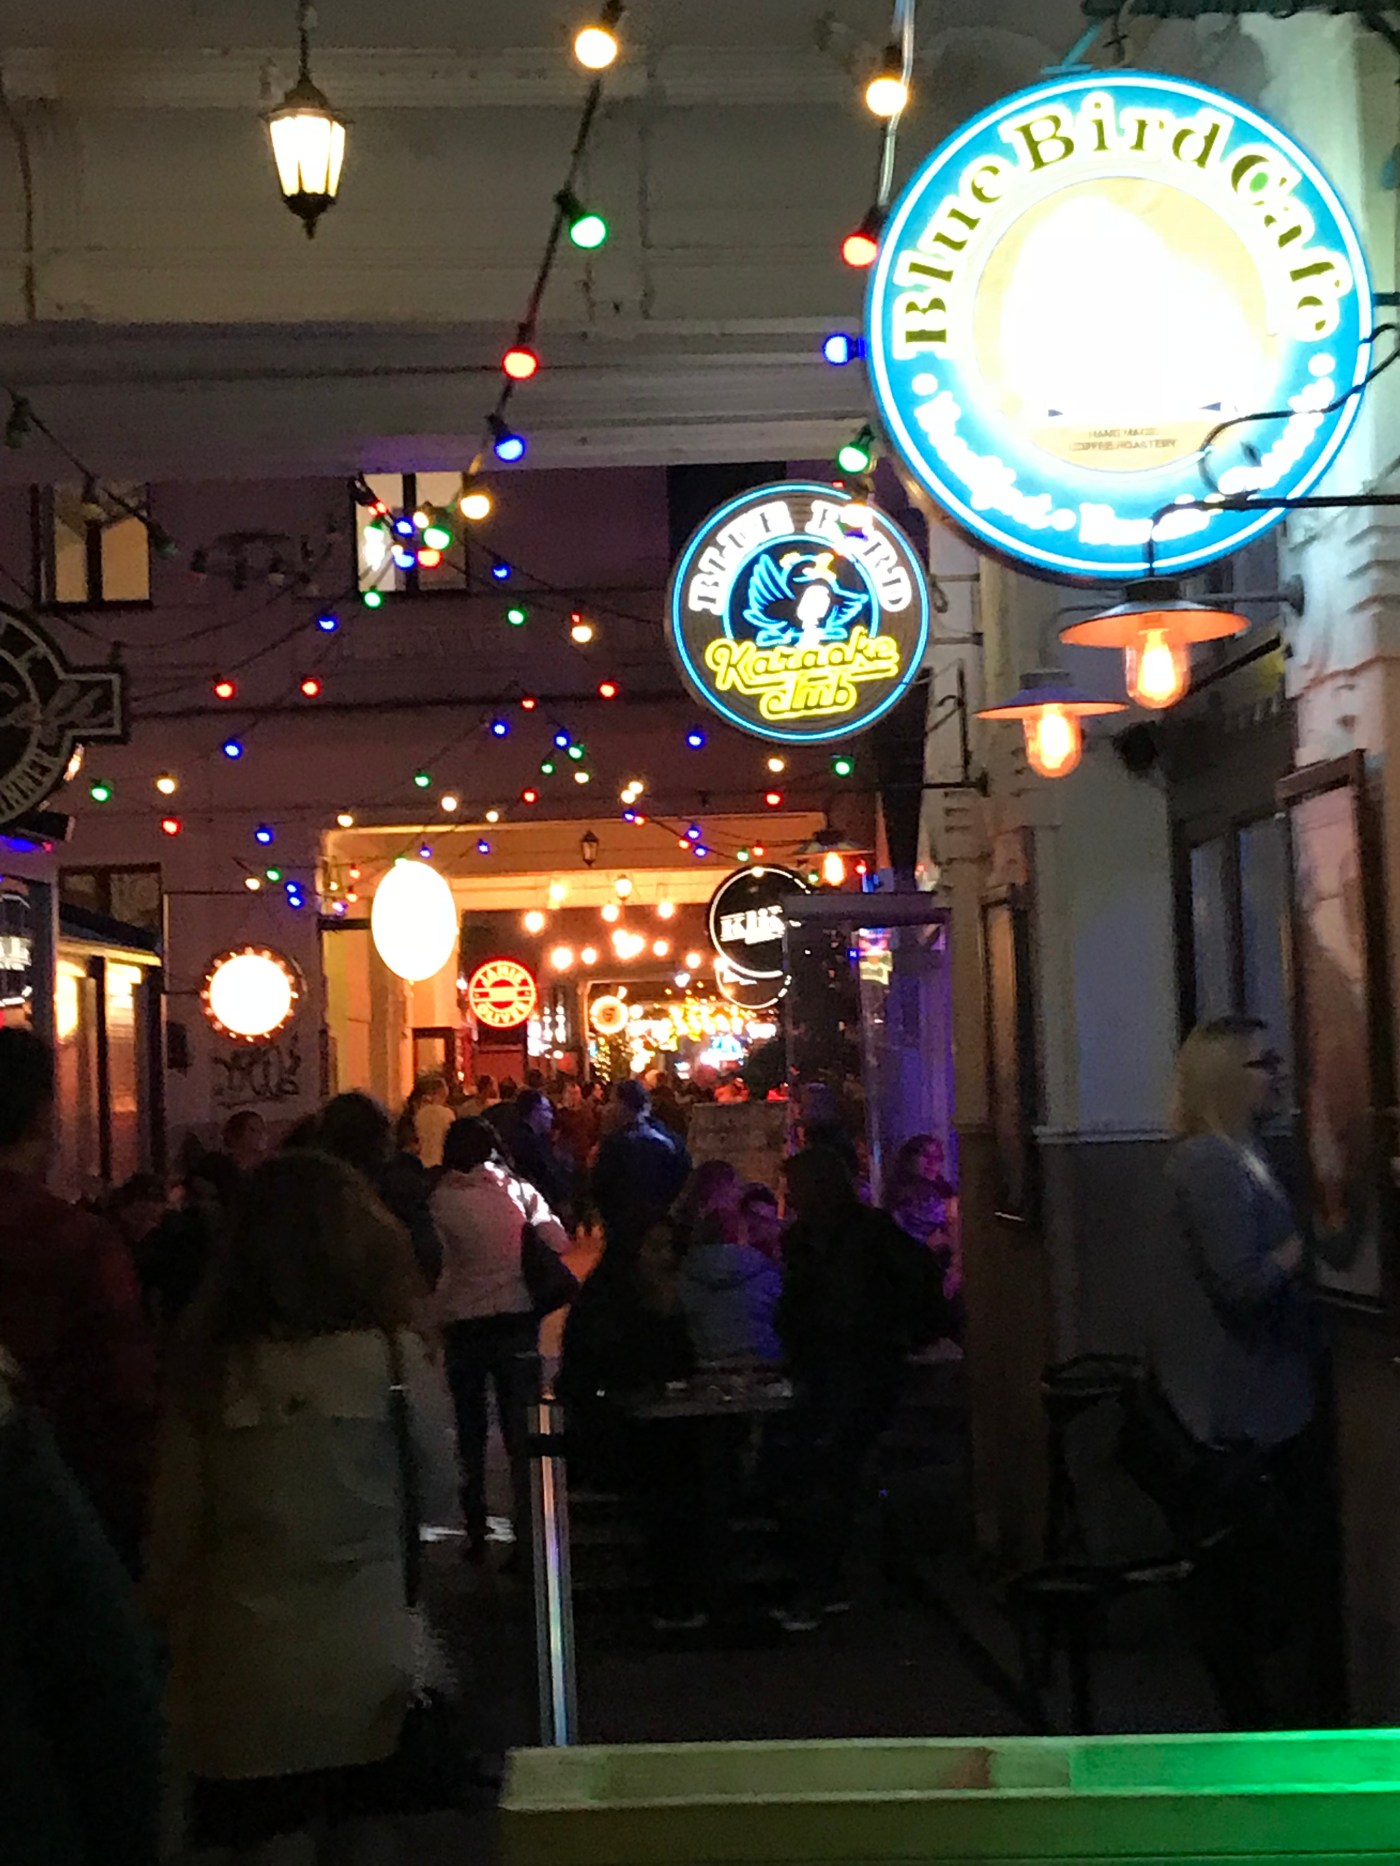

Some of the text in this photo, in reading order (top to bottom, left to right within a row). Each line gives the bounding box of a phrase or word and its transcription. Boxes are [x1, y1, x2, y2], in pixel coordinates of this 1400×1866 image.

[899, 160, 1005, 350] Blue
[1009, 97, 1224, 173] Bird
[804, 500, 911, 611] BRD
[705, 626, 899, 695] Karaoke
